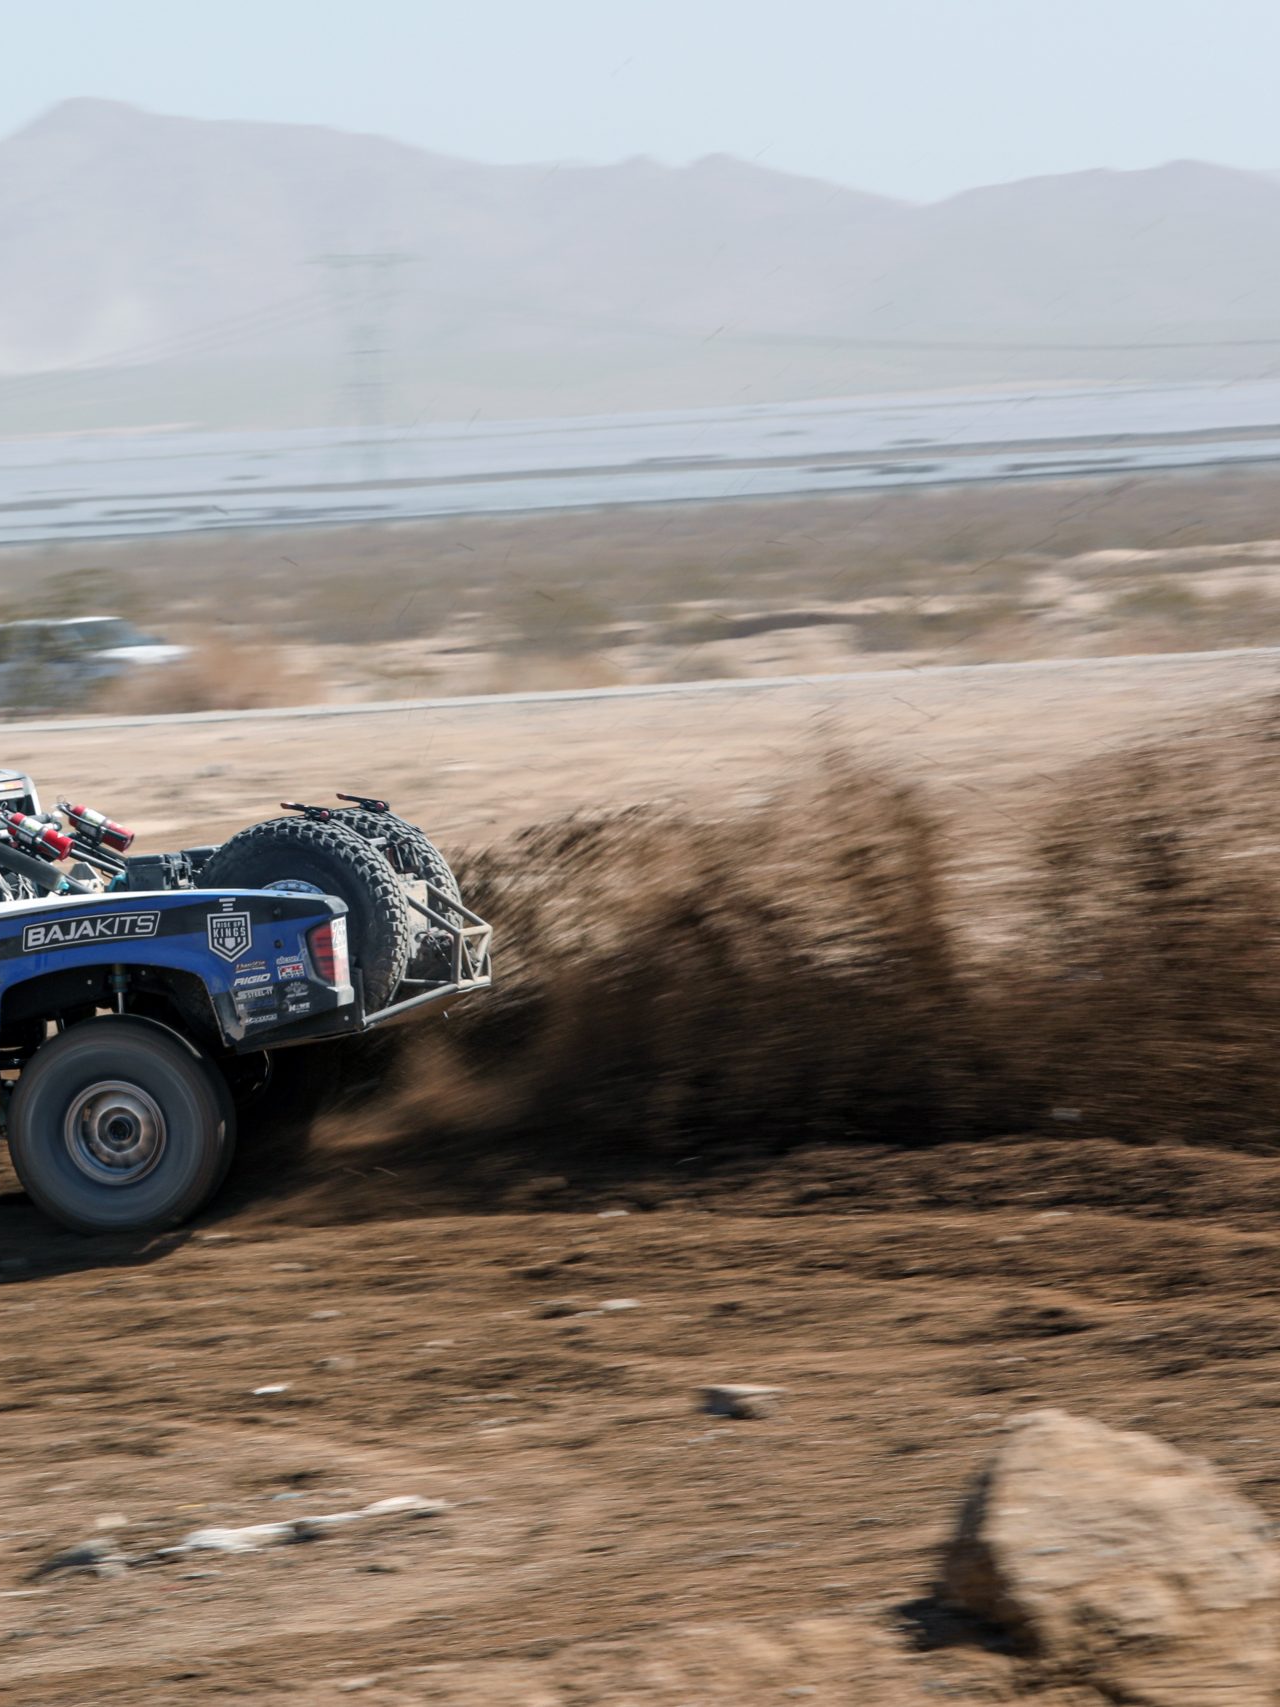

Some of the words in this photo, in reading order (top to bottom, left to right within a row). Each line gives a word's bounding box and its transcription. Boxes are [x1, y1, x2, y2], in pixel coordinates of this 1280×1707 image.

[27, 915, 155, 947] BAJAKITS
[213, 927, 246, 938] KINGS
[234, 973, 272, 987] RIGID
